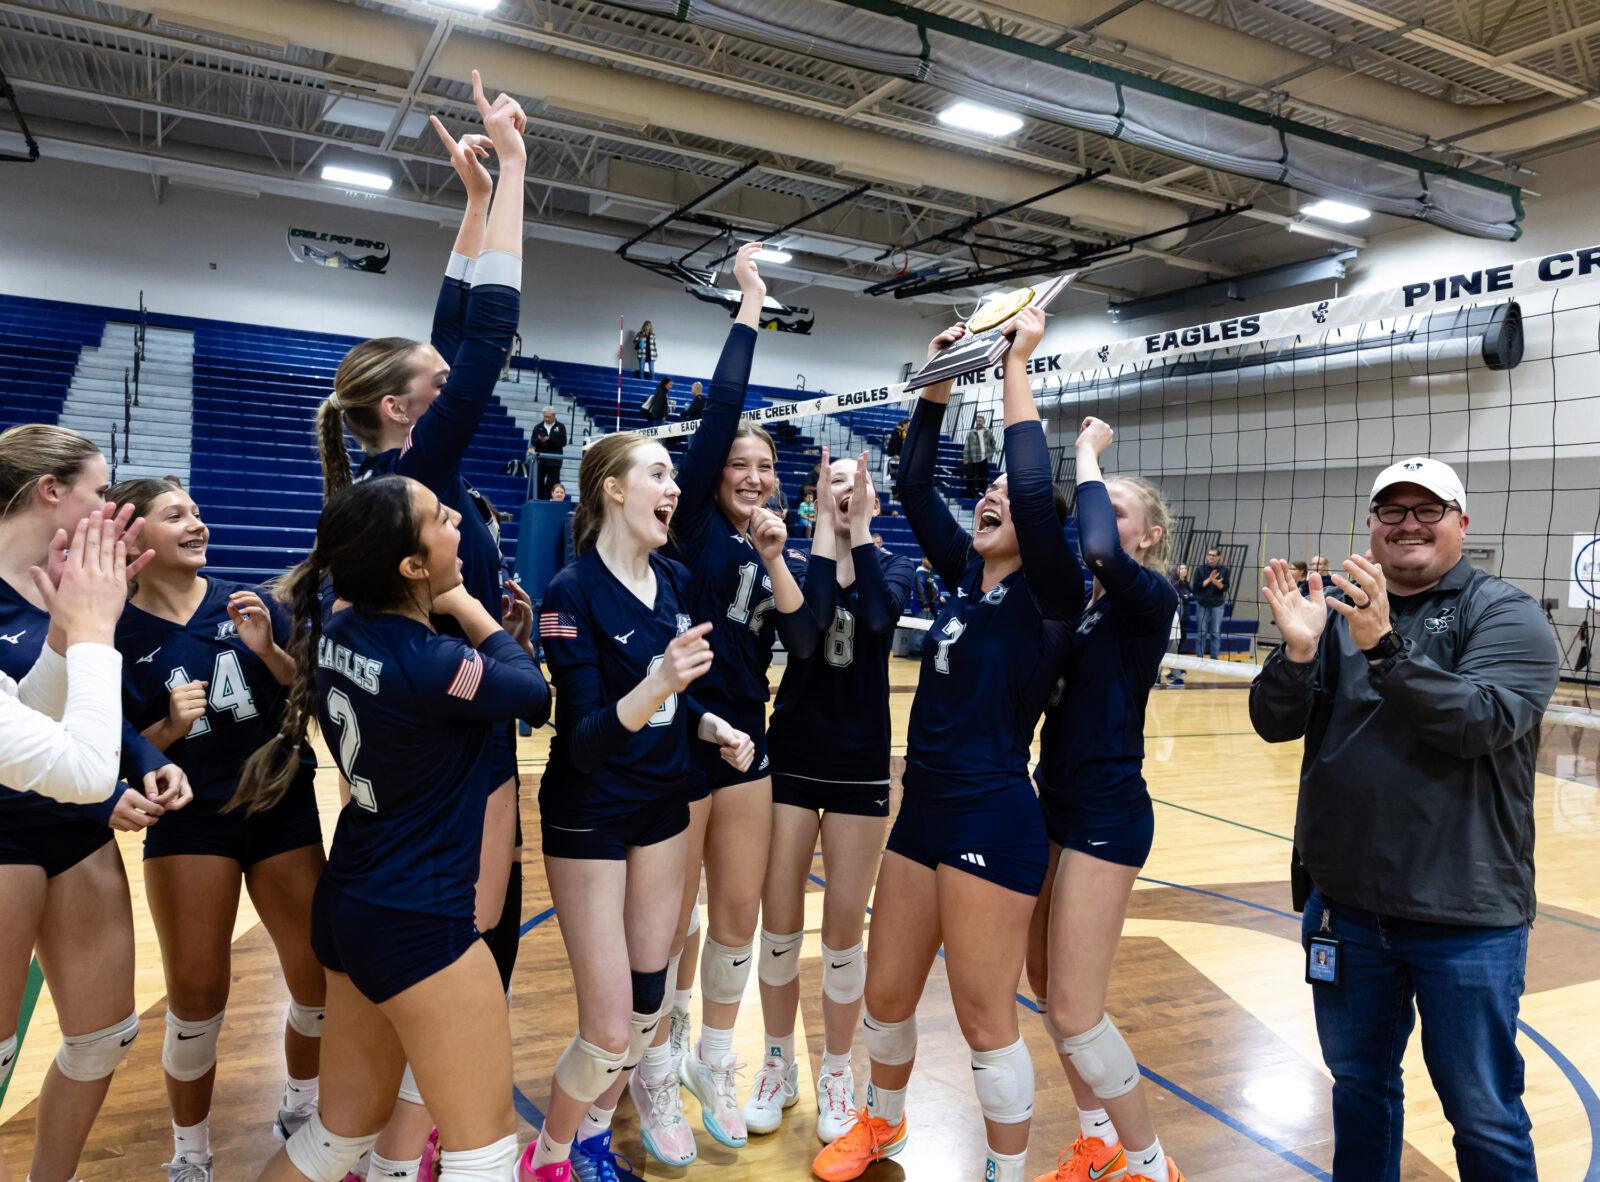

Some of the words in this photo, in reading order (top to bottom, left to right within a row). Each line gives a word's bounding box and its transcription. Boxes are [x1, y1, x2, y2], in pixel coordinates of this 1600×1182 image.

[1402, 264, 1514, 308] PINE
[1145, 315, 1261, 355] EAGLES
[956, 369, 987, 387] INE
[994, 353, 1062, 380] CEEK
[765, 403, 798, 419] CREEK
[837, 386, 889, 407] EAGLES
[680, 420, 699, 432] EAGL
[824, 605, 855, 668] 8
[327, 686, 378, 813] 2
